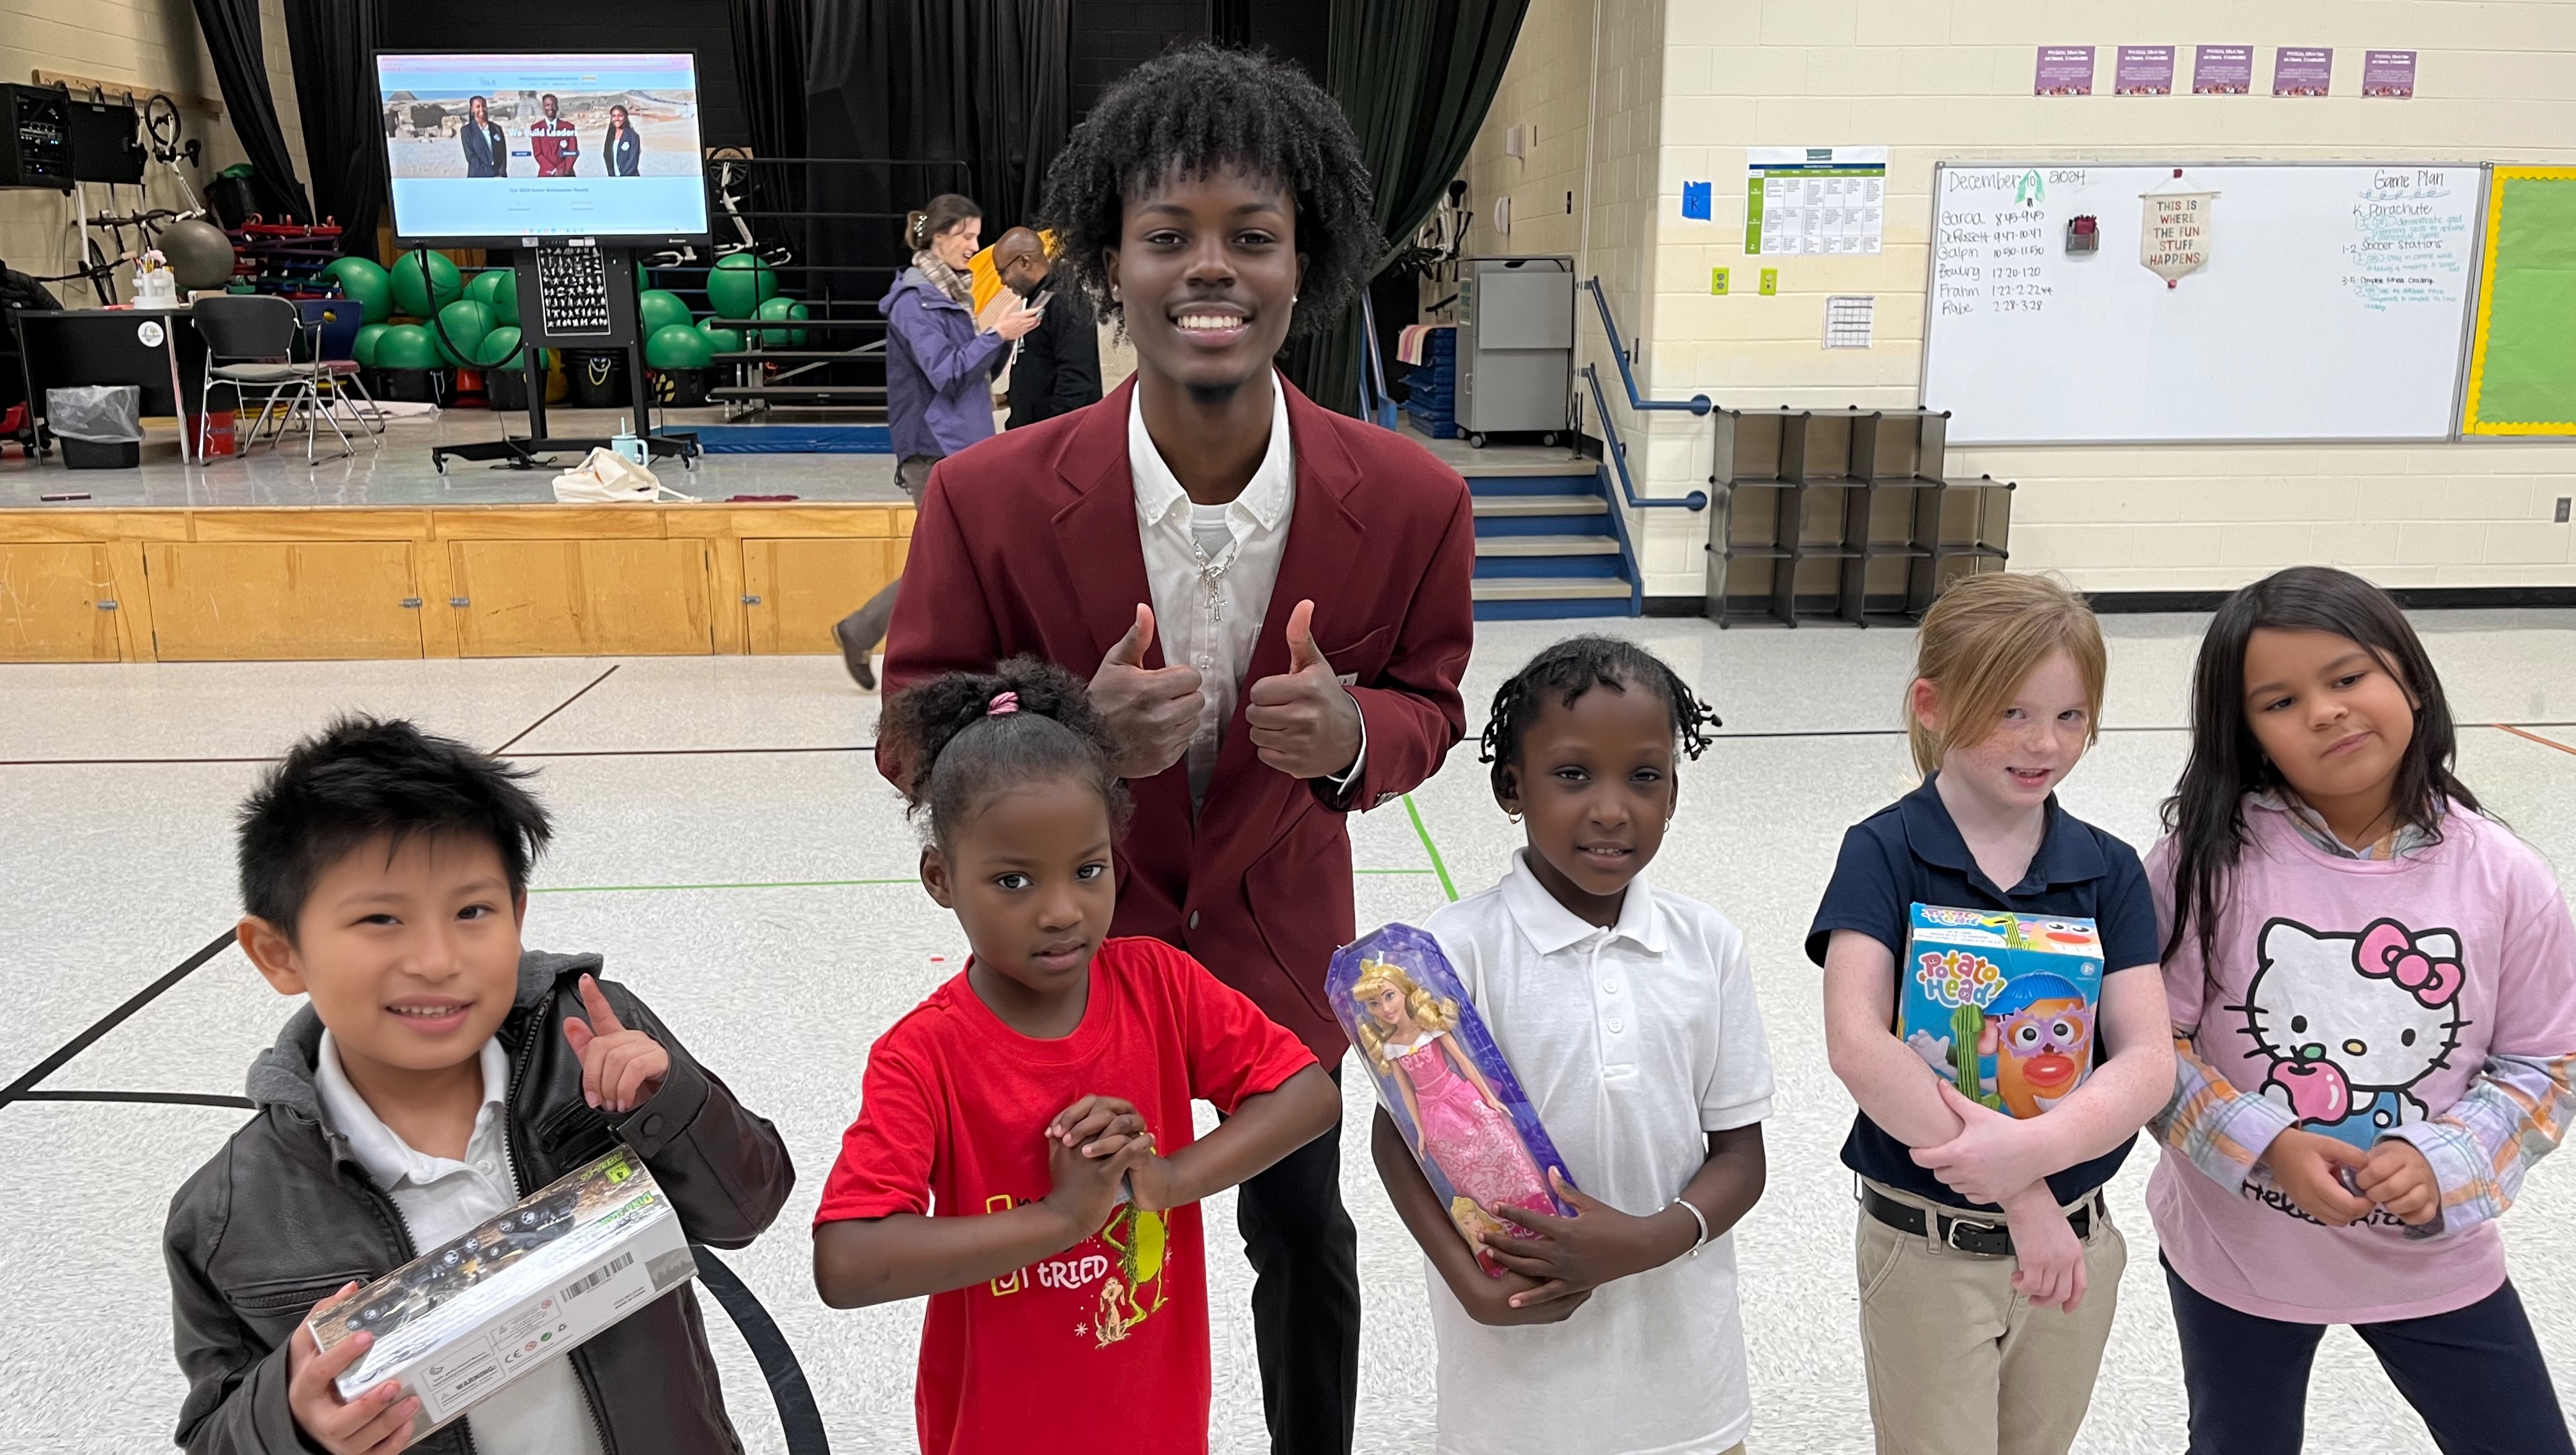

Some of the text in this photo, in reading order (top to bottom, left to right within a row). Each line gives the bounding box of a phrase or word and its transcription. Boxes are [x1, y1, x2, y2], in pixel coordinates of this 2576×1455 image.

[1950, 171, 2021, 192] December
[2049, 170, 2085, 185] 2024
[2373, 169, 2444, 190] Game Plan
[1690, 194, 1702, 212] R
[2157, 200, 2198, 212] THIS IS
[2368, 203, 2433, 218] Parachute
[2160, 213, 2195, 224] WHERE
[2153, 226, 2200, 238] THE FUN
[2159, 239, 2194, 251] STUFF
[2361, 240, 2395, 252] Soccer
[2398, 240, 2444, 250] Stations
[2150, 252, 2201, 266] HAPPENS
[1942, 300, 1974, 315] Rabe
[1920, 951, 1998, 985] Potato
[1926, 978, 1994, 1006] Head
